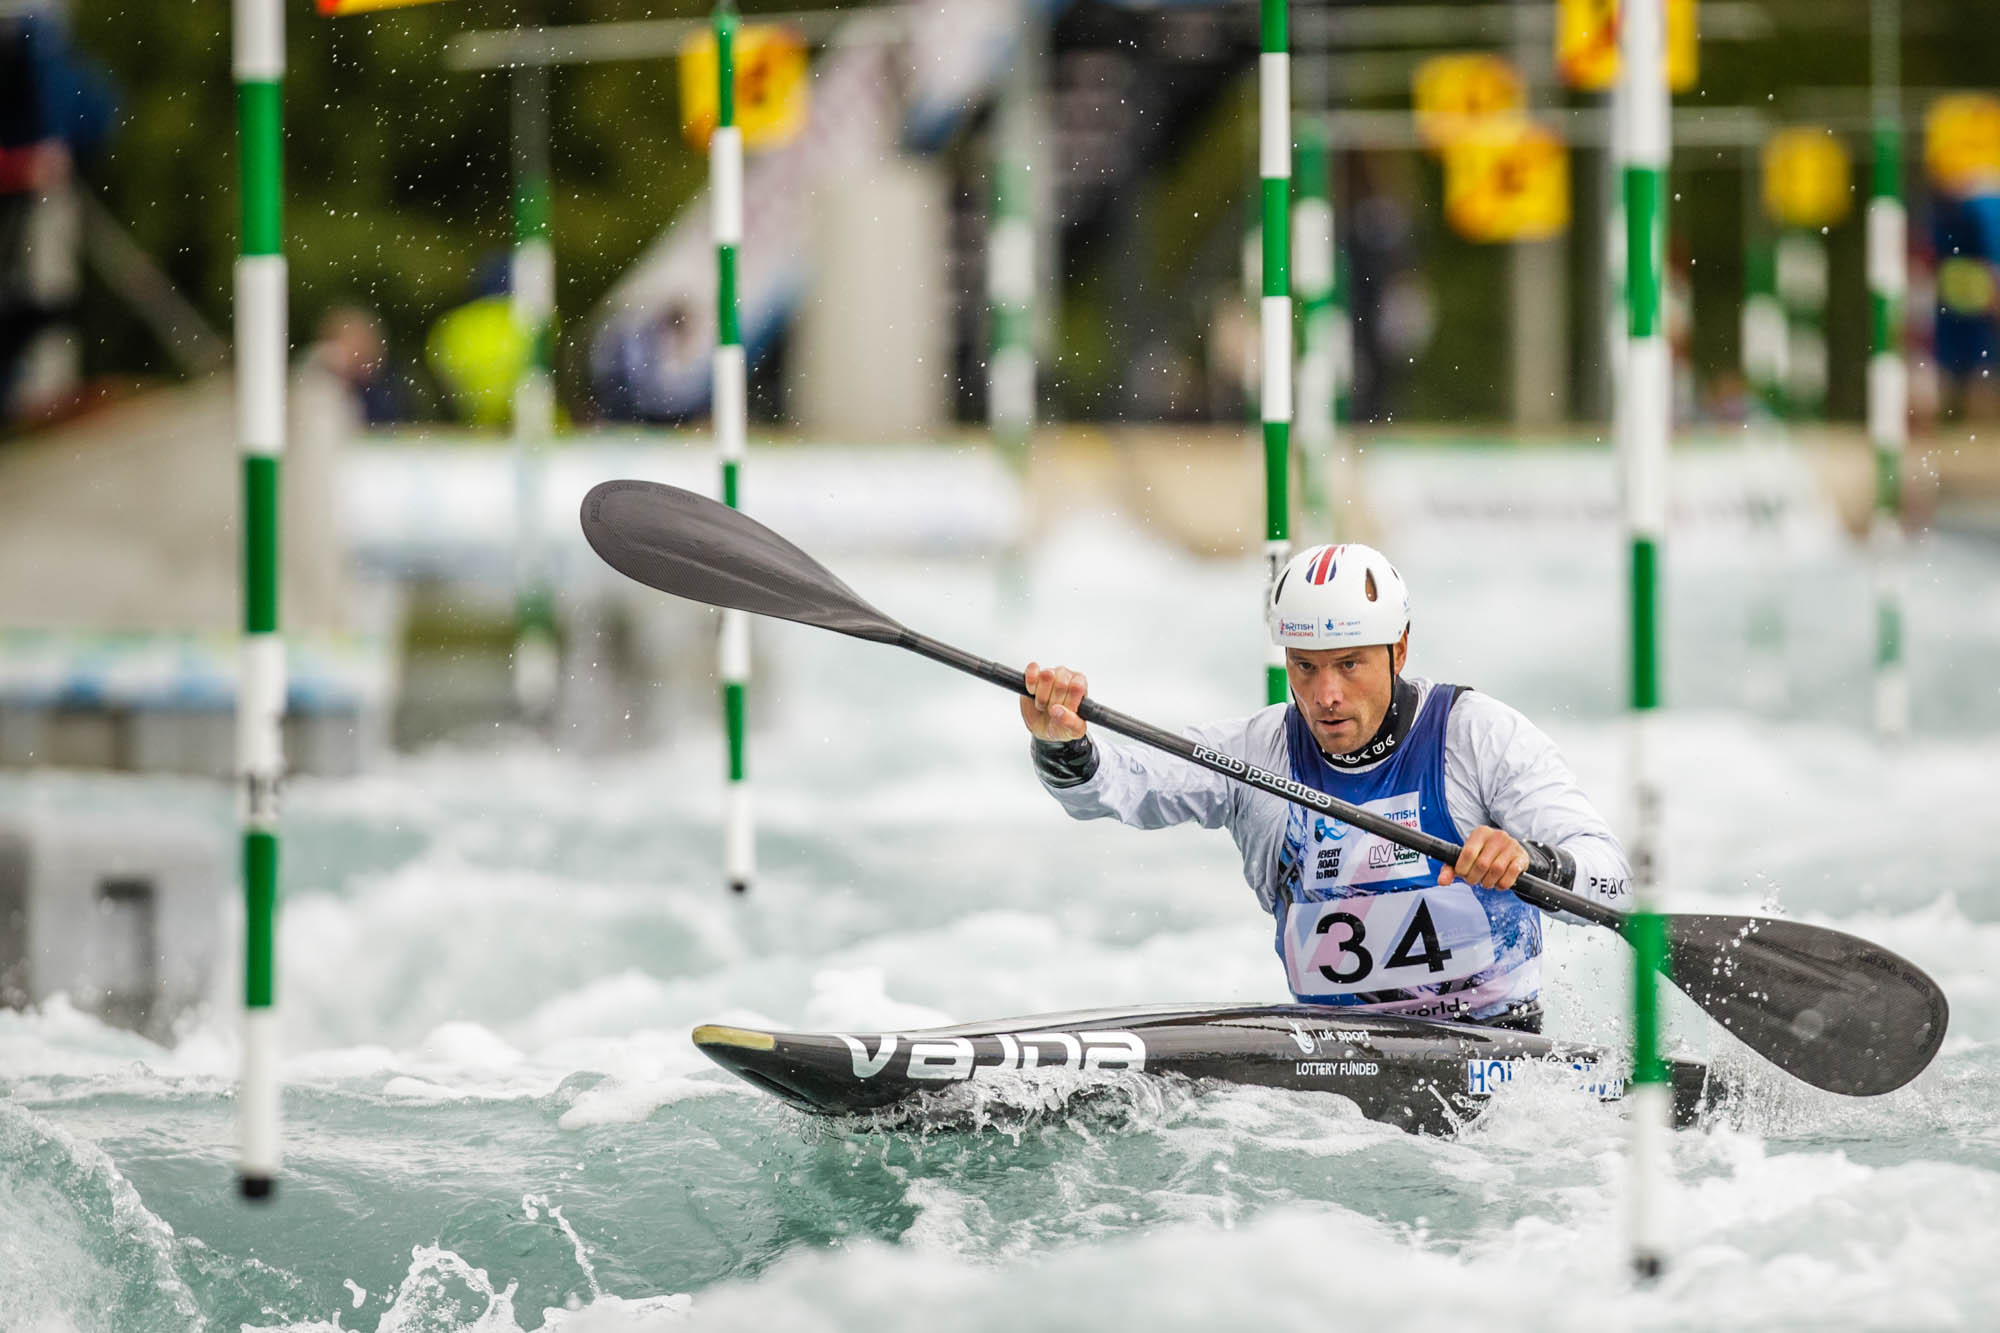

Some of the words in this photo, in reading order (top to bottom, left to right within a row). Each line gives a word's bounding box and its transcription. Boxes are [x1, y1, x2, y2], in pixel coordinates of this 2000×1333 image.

[1193, 745, 1245, 773] raab
[1246, 765, 1331, 808] paddles
[1324, 868, 1339, 879] RIO
[1316, 898, 1452, 984] 34
[1319, 1029, 1336, 1041] uk
[1337, 1029, 1371, 1044] sport
[1296, 1062, 1338, 1076] LOTTERY
[1340, 1061, 1379, 1076] FUNDED
